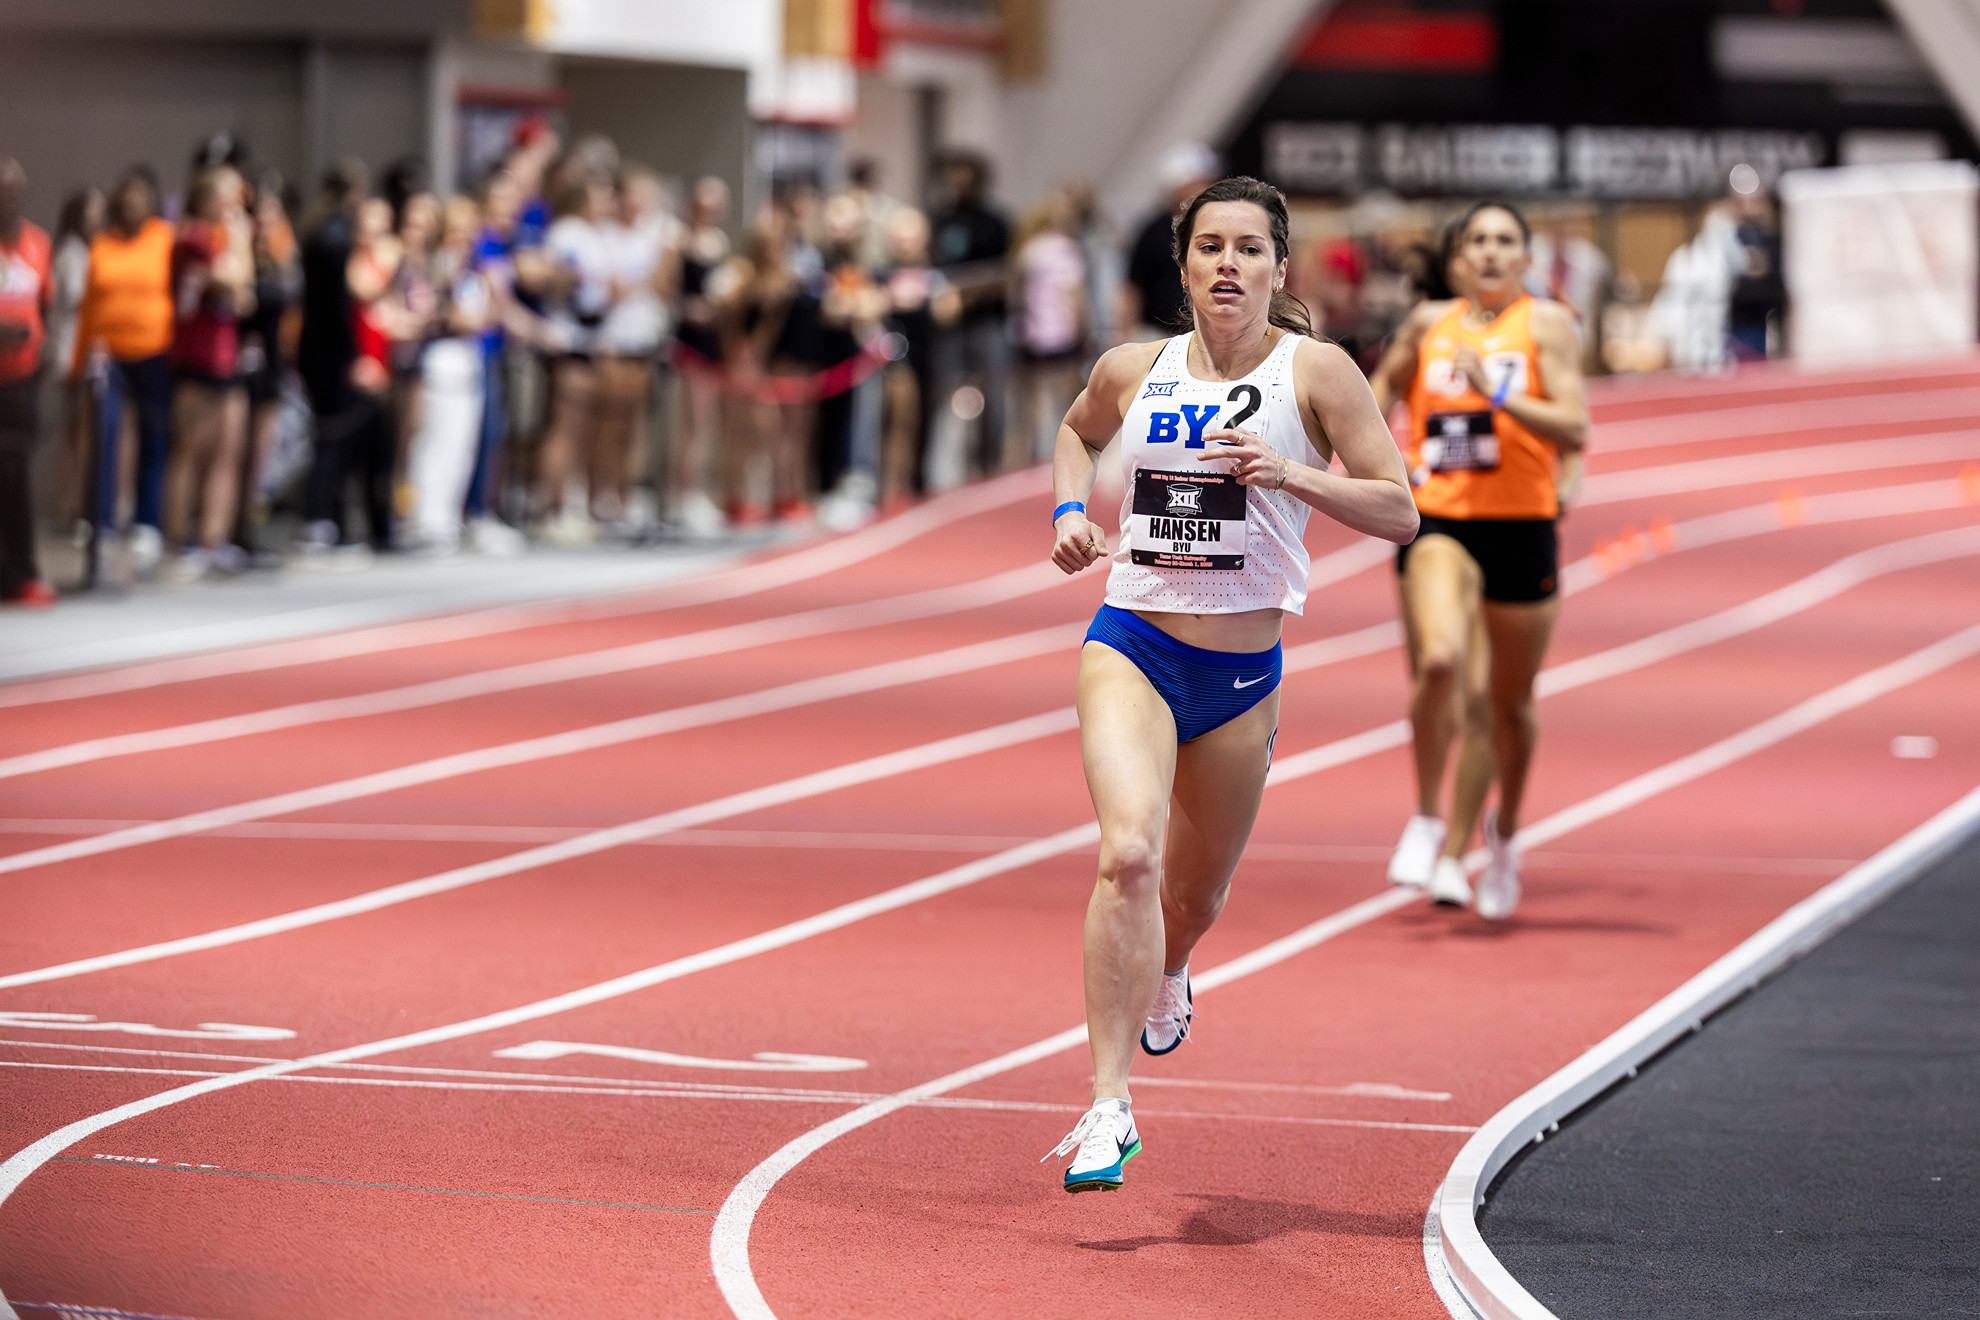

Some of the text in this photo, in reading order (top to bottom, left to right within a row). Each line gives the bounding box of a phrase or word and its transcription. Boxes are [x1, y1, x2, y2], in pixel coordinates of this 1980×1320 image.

[1223, 384, 1262, 430] 2
[1147, 404, 1236, 449] BY
[1149, 517, 1221, 542] HANSEN
[1173, 542, 1191, 553] BYU
